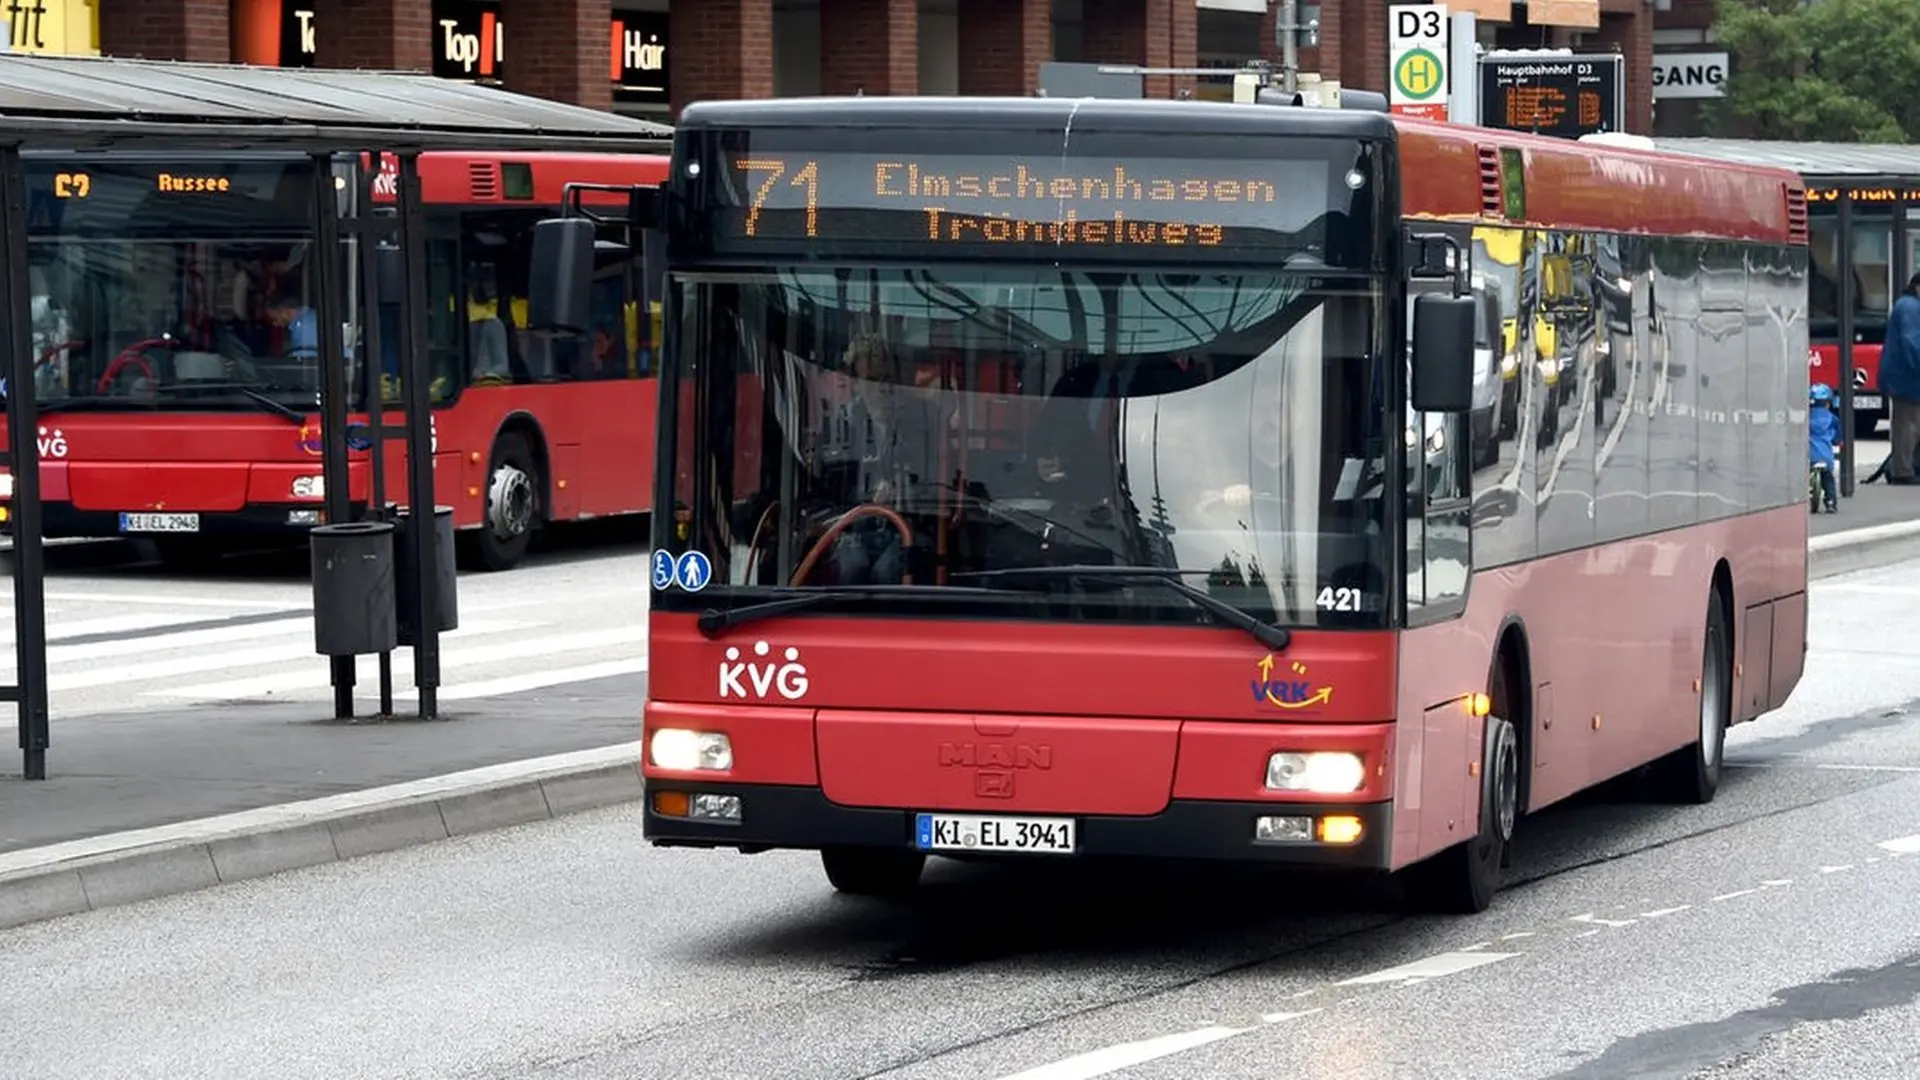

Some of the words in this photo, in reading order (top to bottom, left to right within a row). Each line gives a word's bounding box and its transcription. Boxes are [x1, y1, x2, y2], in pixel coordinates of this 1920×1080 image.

[1398, 11, 1440, 38] D3
[439, 19, 479, 72] Top
[624, 29, 665, 70] Hair
[1497, 64, 1572, 76] Hauptbahnhof
[1577, 64, 1593, 74] D3
[158, 173, 230, 191] Russee
[876, 163, 1275, 202] Elmschenhagen
[736, 160, 818, 237] 71
[923, 207, 1223, 244] Tröndelweg
[37, 438, 68, 457] VG
[1316, 586, 1360, 612] 421
[719, 662, 808, 699] KVG
[938, 743, 1052, 770] MAN
[980, 821, 1008, 846] EL
[1015, 822, 1070, 849] 3941
